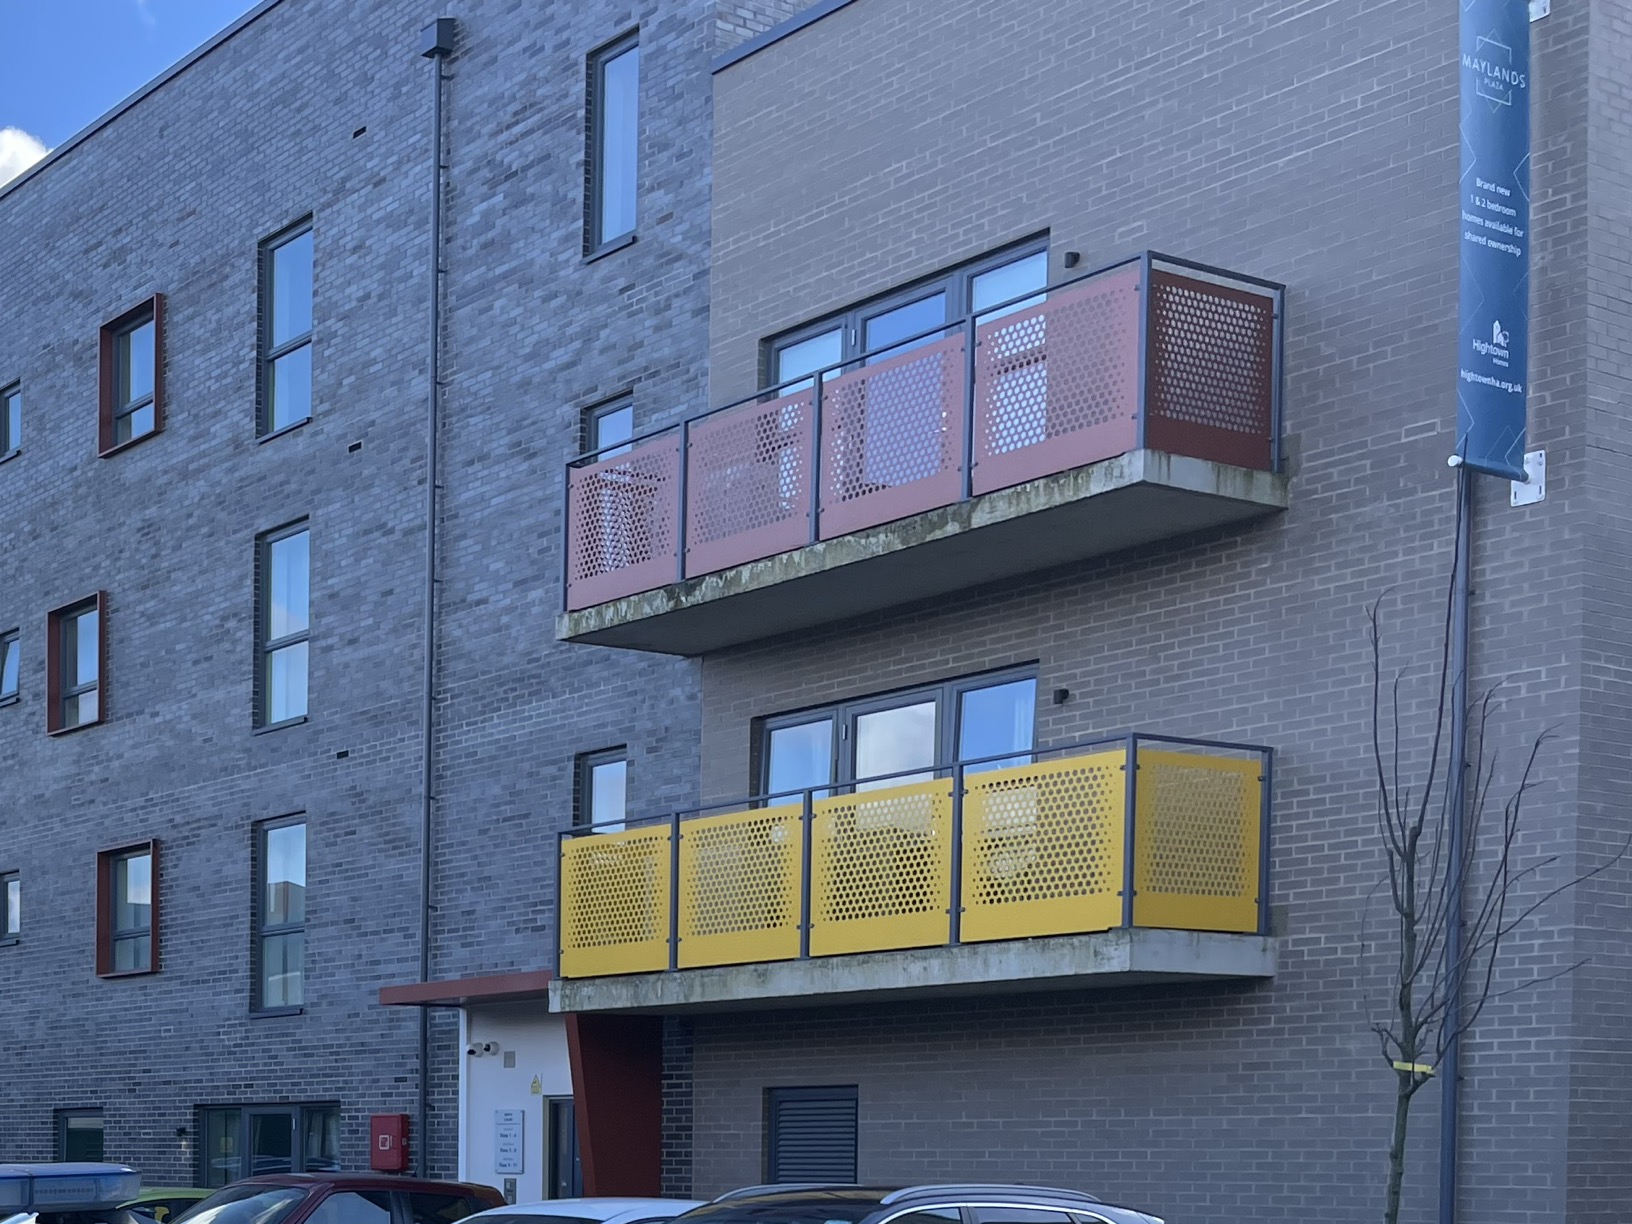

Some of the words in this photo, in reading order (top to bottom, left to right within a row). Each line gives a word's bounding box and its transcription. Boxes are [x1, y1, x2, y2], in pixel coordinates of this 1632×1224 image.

[1462, 53, 1526, 88] MAYLANDS
[1483, 77, 1504, 90] PLAZA
[1475, 177, 1496, 192] Brand
[1496, 186, 1511, 197] new
[1475, 196, 1481, 206] &
[1481, 198, 1486, 208] 2
[1486, 199, 1517, 217] bedroom
[1462, 209, 1484, 226] homes
[1484, 219, 1514, 235] available
[1514, 226, 1524, 238] for
[1464, 230, 1487, 246] shared
[1487, 239, 1522, 258] ownership
[1472, 338, 1509, 359] Hightown
[1460, 368, 1523, 393] hightownha.org.uk
